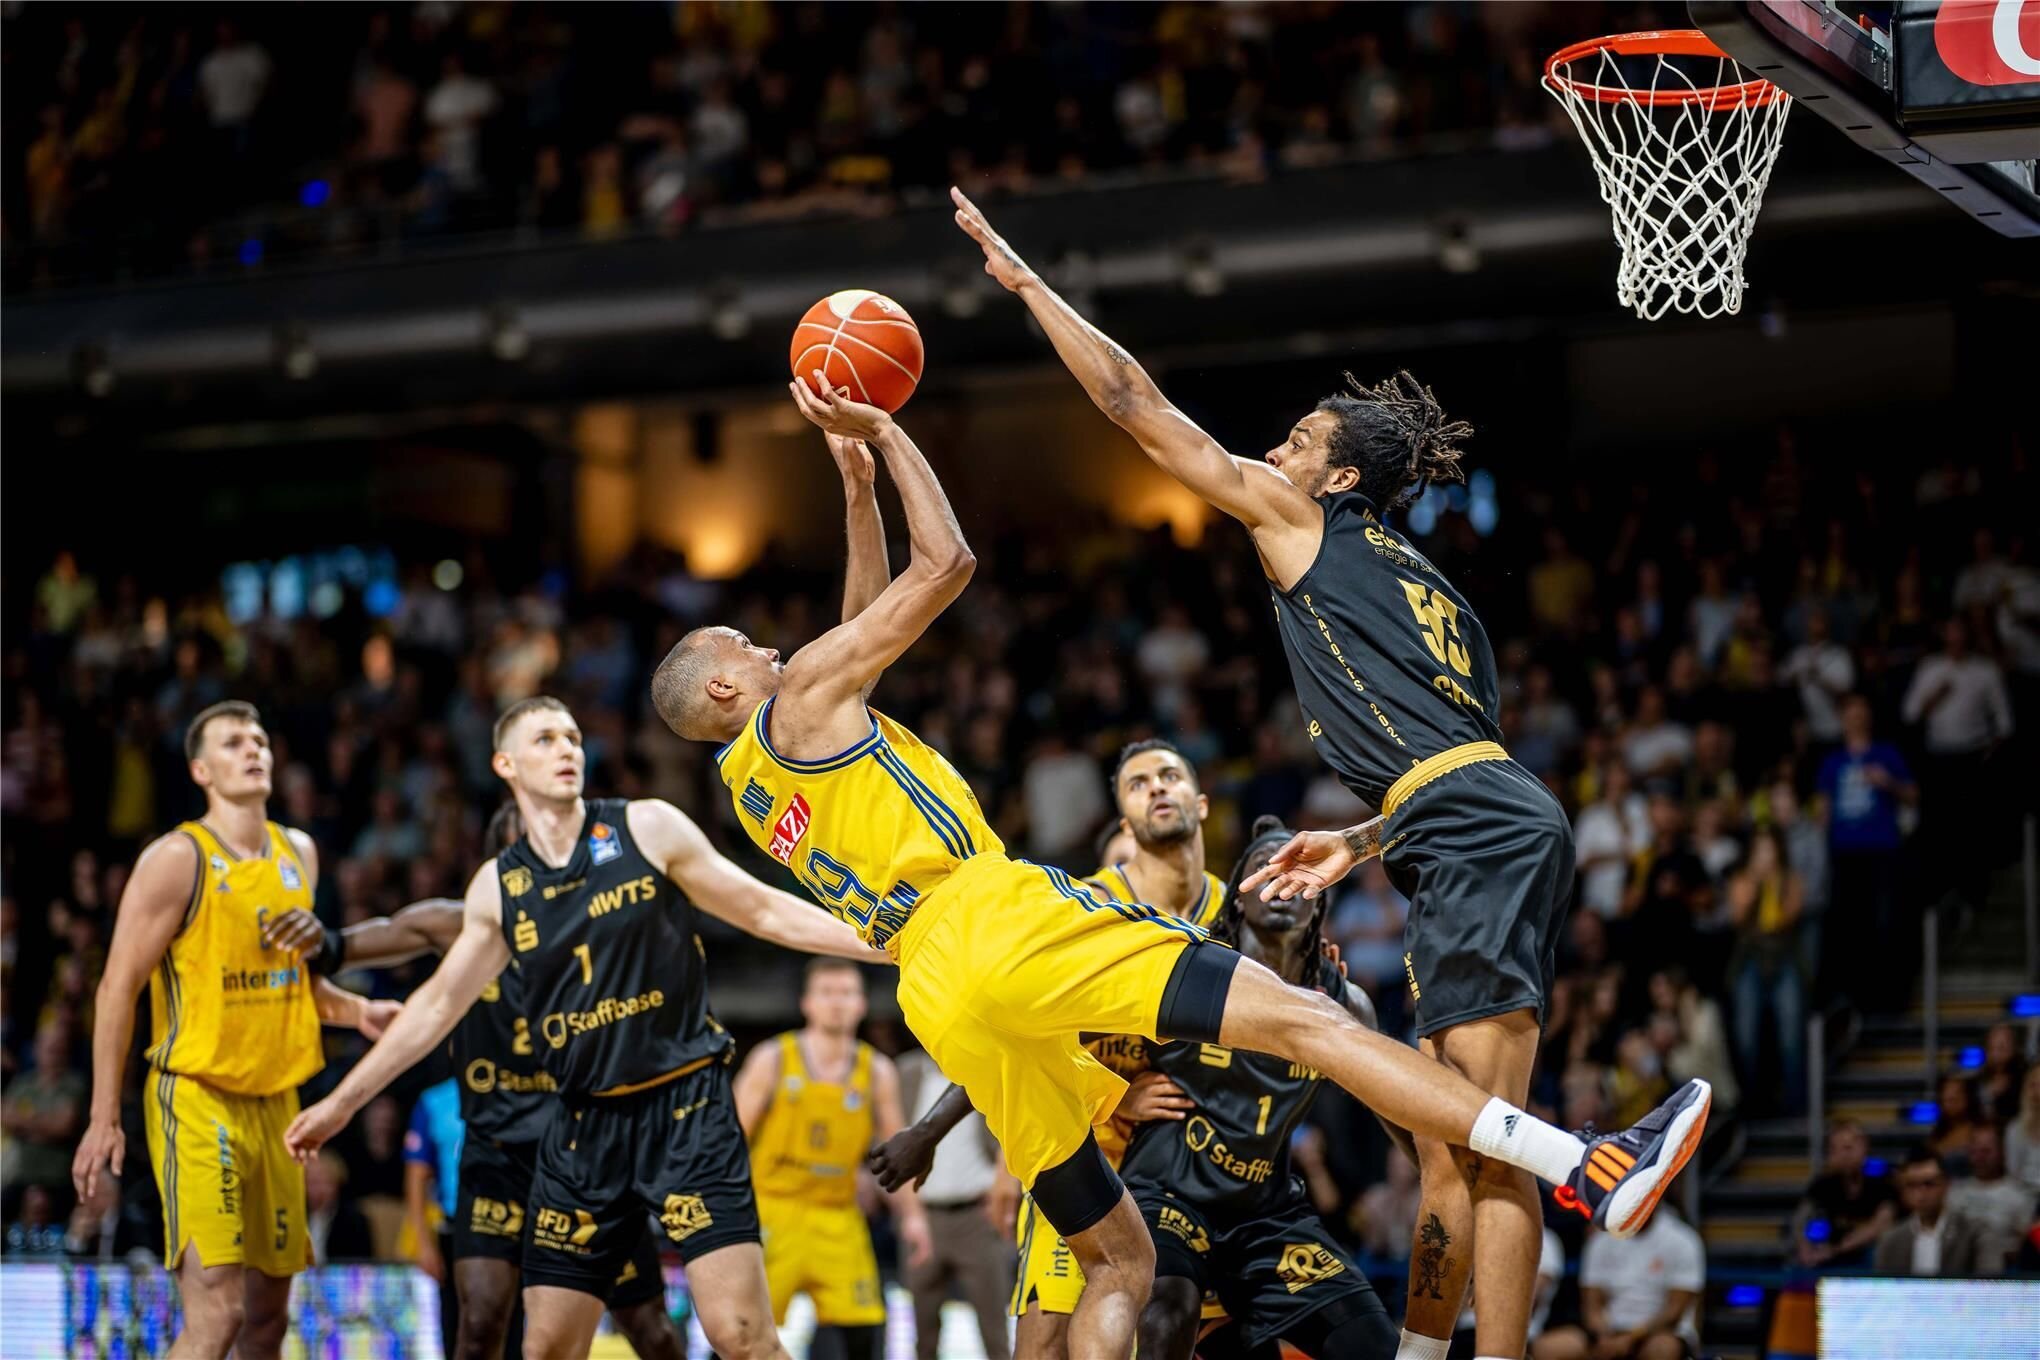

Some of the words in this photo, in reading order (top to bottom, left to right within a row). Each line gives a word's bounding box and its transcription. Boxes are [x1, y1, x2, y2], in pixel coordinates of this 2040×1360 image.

[1375, 547, 1407, 565] energie
[1303, 594, 1365, 692] PLAYOFFS
[598, 875, 657, 915] WTS
[567, 990, 664, 1035] Staffbase
[1098, 1036, 1147, 1060] inte
[1255, 1095, 1272, 1136] 1
[537, 1207, 571, 1234] IFD
[1045, 1236, 1071, 1277] inte
